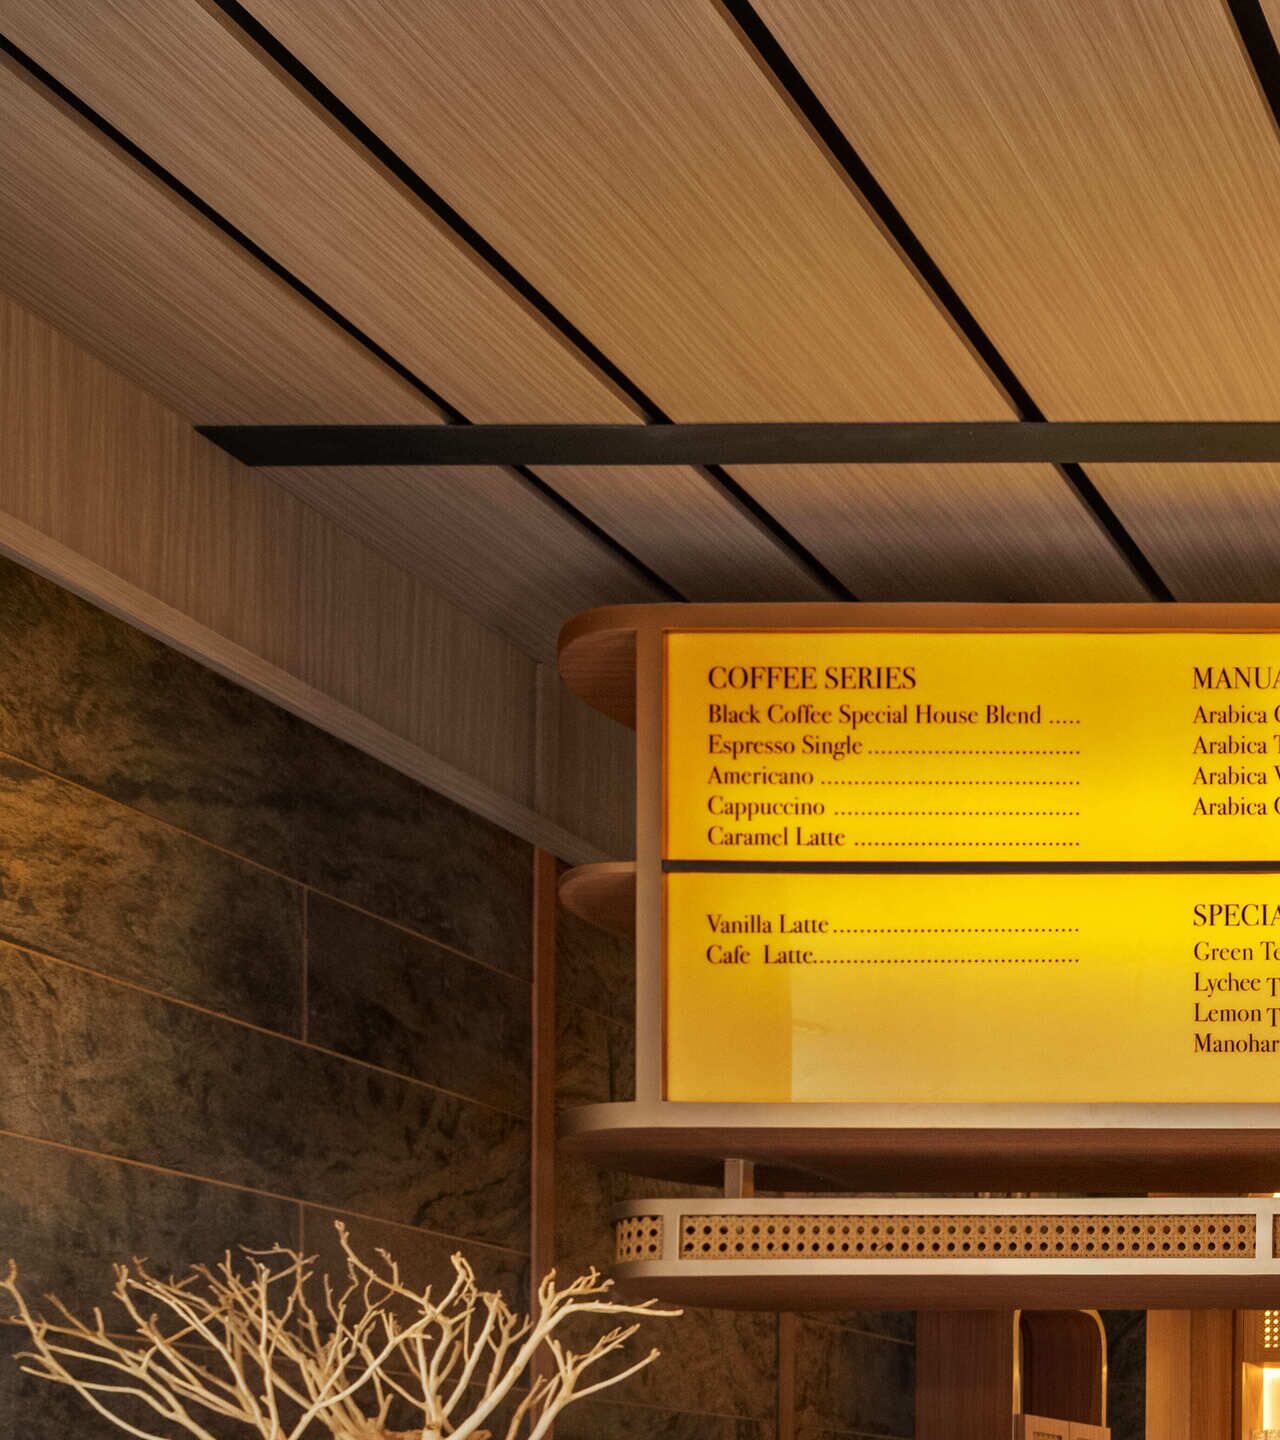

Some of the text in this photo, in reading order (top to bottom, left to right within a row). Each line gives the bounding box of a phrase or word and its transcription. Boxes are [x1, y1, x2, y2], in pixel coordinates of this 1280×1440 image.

[708, 666, 916, 689] COFFEE SERIES
[709, 704, 1041, 730] Black Coffee Special House Blend
[1193, 704, 1267, 724] Arabica
[708, 734, 862, 760] Espresso Single
[1193, 735, 1267, 754] Arabica
[708, 766, 814, 784] Americano
[1193, 765, 1267, 785] Arabica
[708, 796, 825, 821] Cappuccino
[1193, 796, 1267, 815] Arabica
[708, 826, 845, 846] Caramel Latte
[707, 914, 829, 934] Vanilla Latte
[706, 944, 813, 964] Cafe Latte
[1194, 942, 1253, 960] Green
[1195, 972, 1261, 997] Lychee
[1195, 1003, 1261, 1022] Lemon
